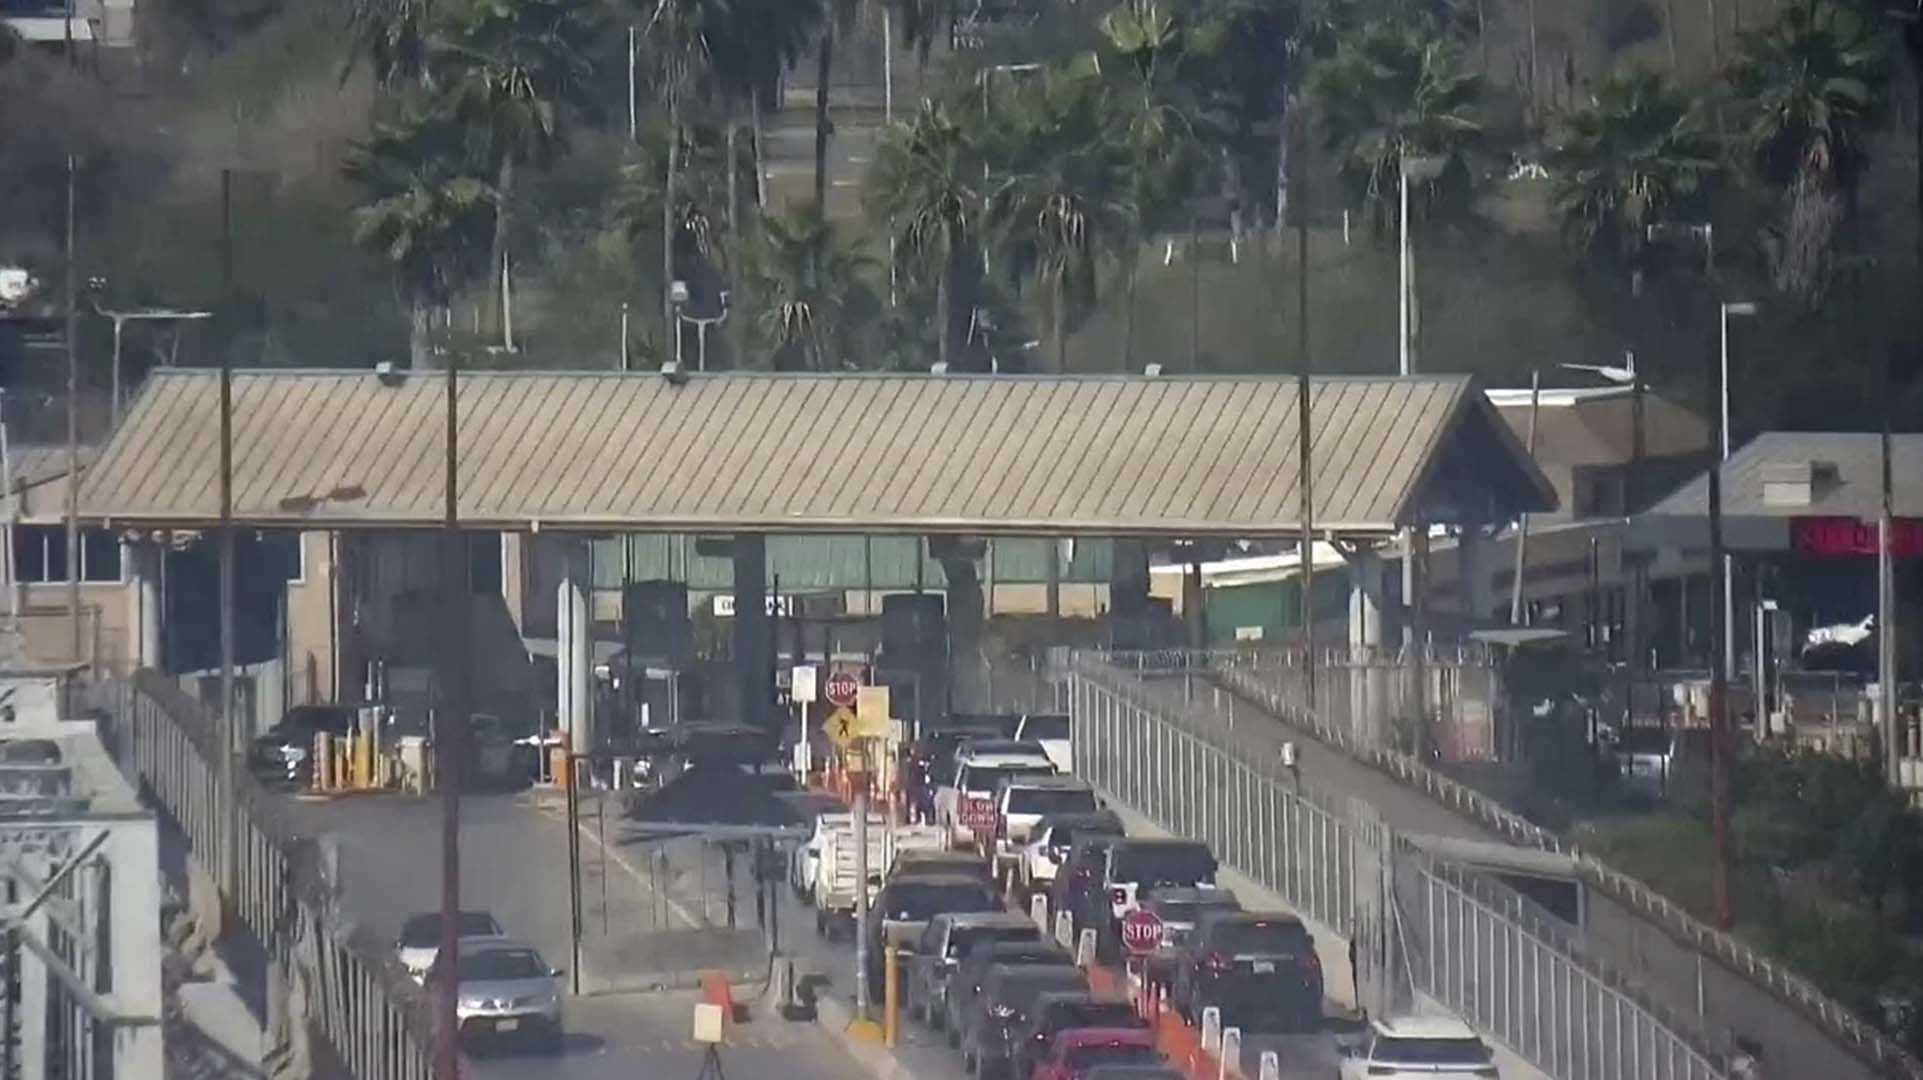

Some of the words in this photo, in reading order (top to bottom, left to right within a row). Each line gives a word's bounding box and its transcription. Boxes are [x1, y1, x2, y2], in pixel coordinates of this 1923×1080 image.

[829, 681, 856, 696] STOP
[962, 801, 993, 812] SLOW
[1126, 924, 1161, 940] STOP
